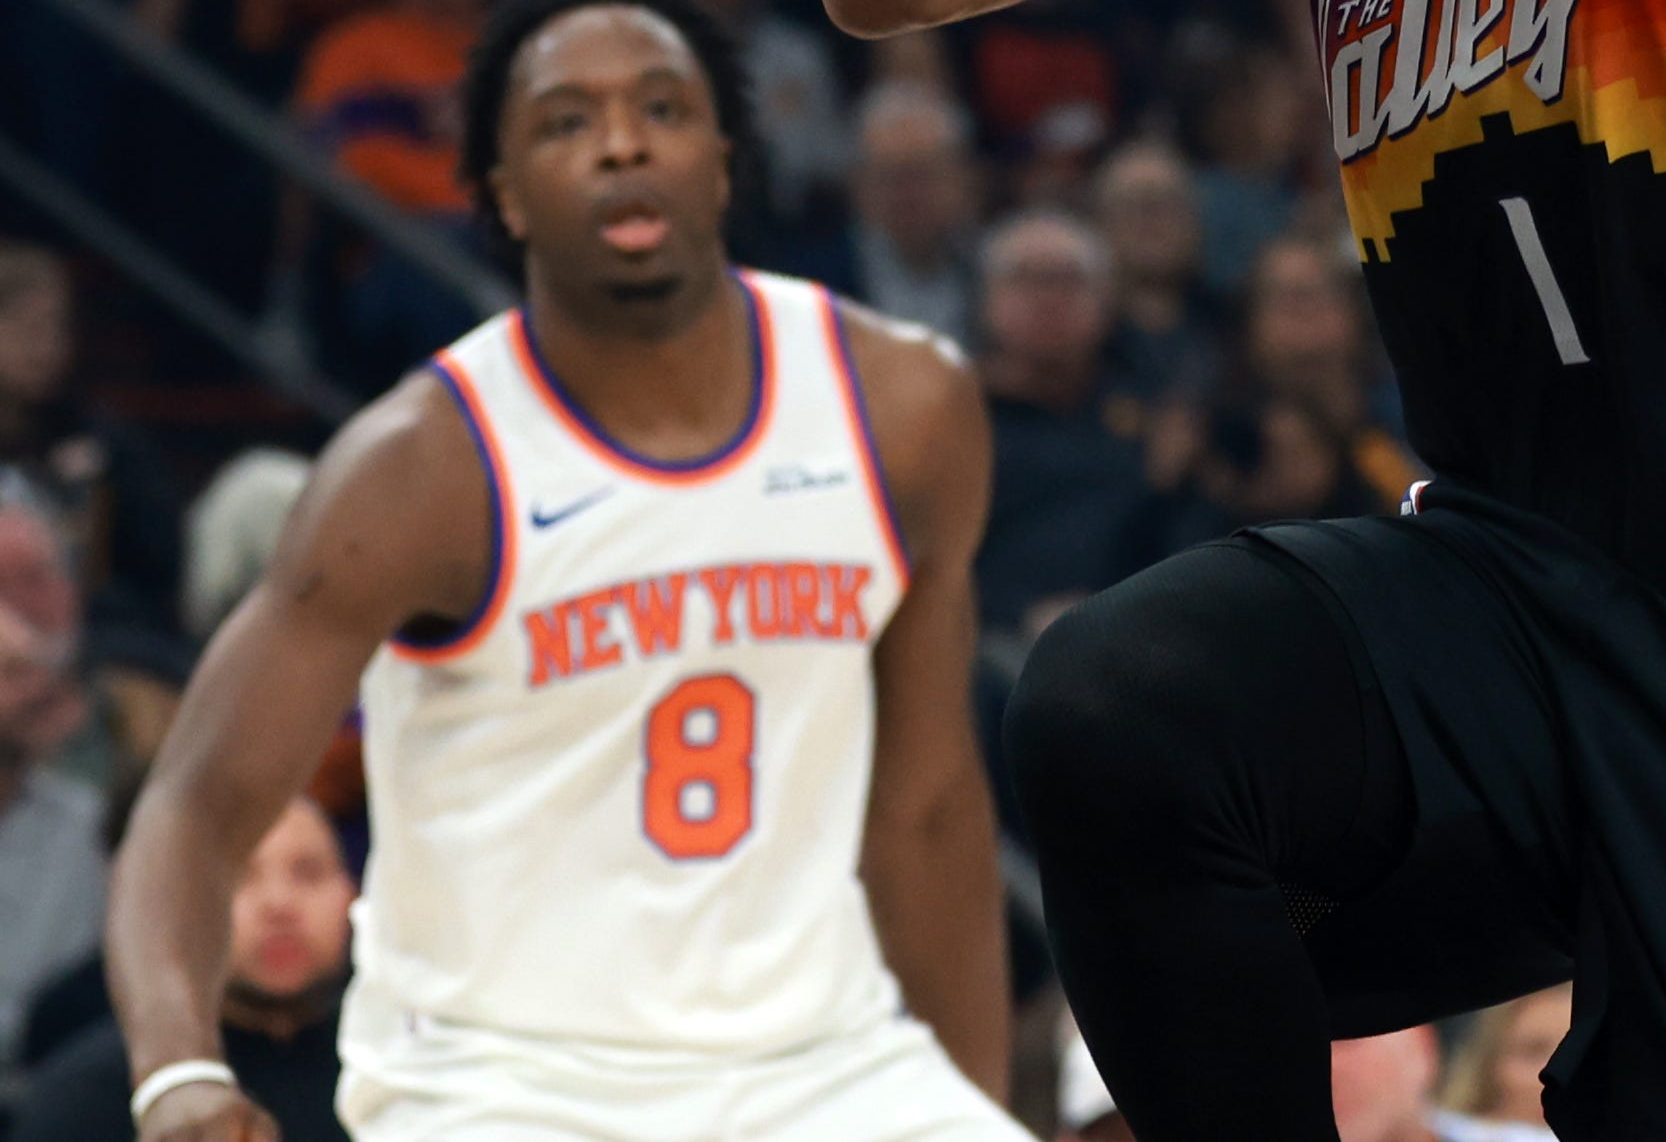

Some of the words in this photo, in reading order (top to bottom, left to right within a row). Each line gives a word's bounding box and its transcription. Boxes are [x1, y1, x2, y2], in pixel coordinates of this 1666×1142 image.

[1499, 196, 1591, 366] 1
[522, 572, 688, 688] NEW
[699, 560, 873, 644] YORK
[641, 671, 756, 865] 8
